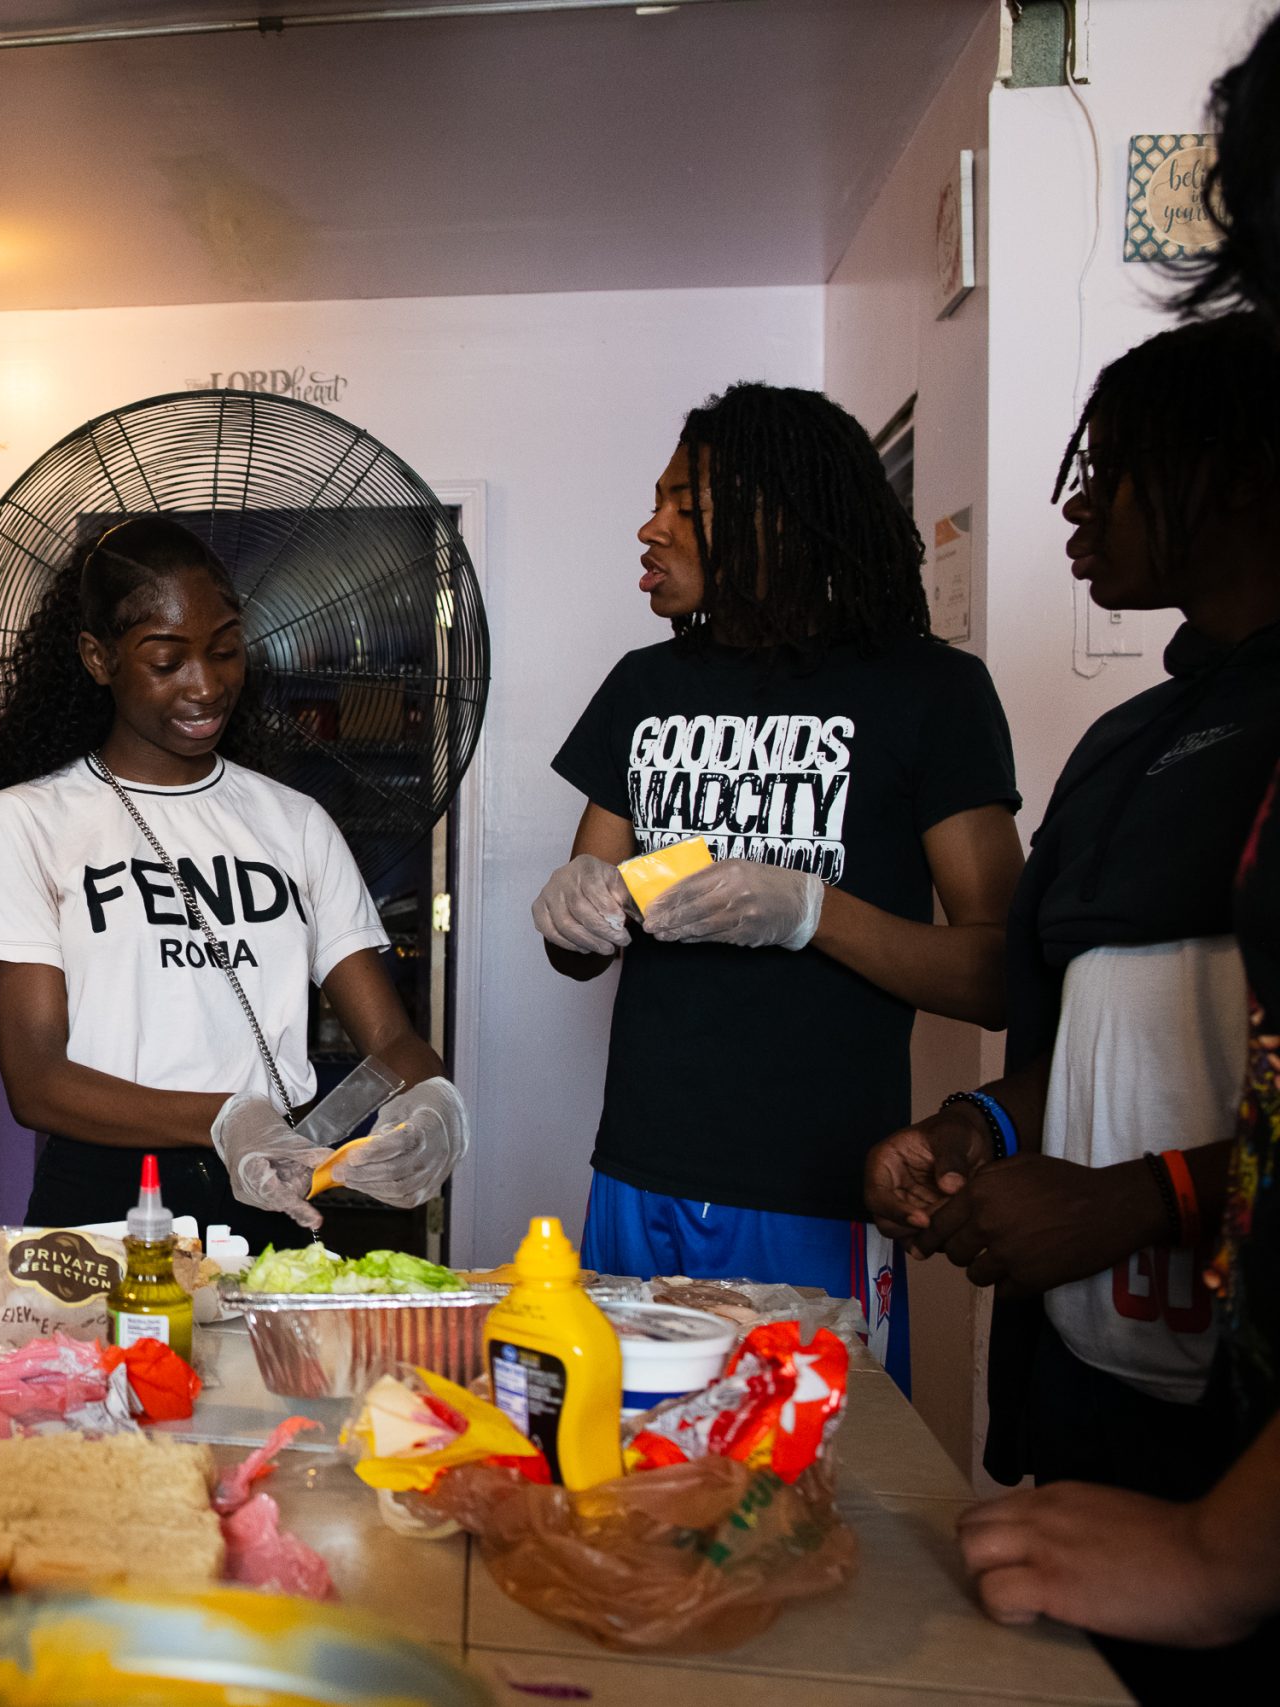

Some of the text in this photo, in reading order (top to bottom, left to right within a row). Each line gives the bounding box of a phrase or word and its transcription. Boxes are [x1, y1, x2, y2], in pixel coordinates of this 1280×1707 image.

[282, 366, 348, 405] heart
[160, 938, 259, 969] ROMA
[23, 1247, 109, 1278] PRIVATE
